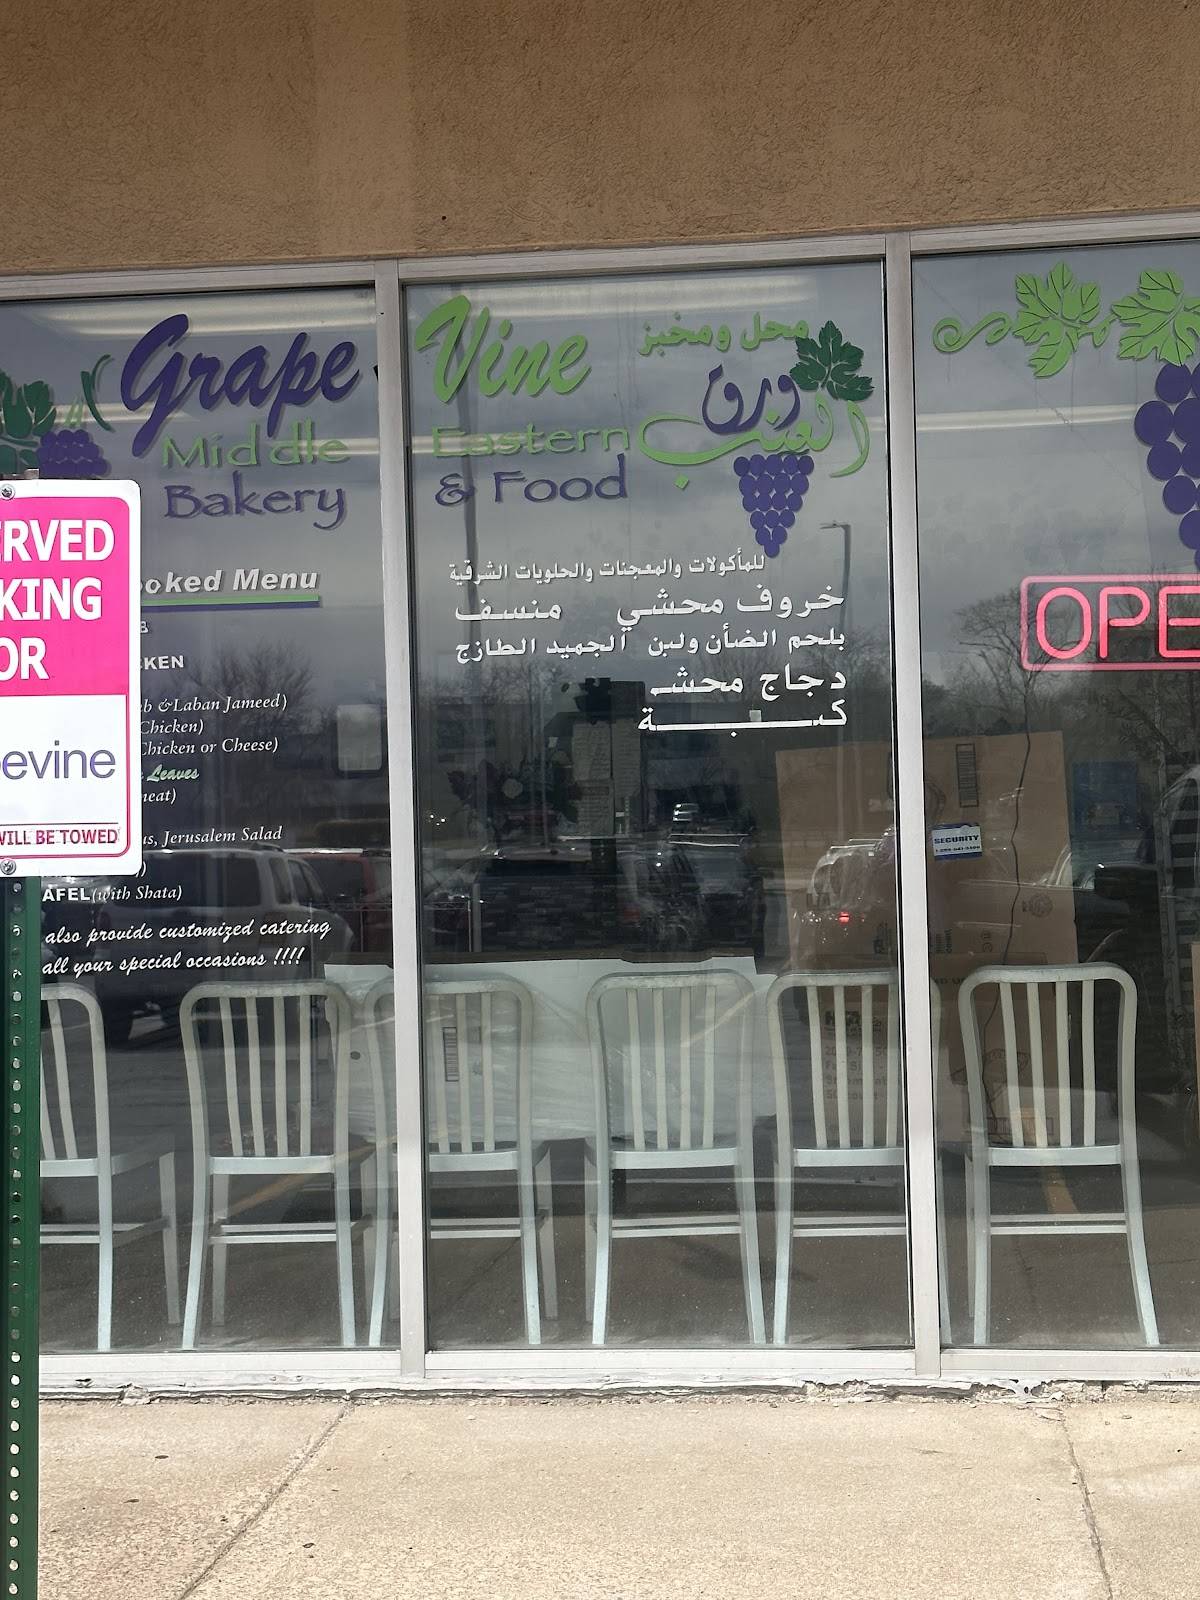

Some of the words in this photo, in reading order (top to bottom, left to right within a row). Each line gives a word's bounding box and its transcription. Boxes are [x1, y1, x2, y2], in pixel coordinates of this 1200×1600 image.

[638, 312, 731, 356] ومخبز
[741, 312, 809, 351] محل
[121, 314, 359, 457] Grape
[415, 295, 591, 403] Vine
[703, 364, 801, 435] ورق
[162, 418, 349, 468] Middle
[432, 423, 629, 458] Eastern
[637, 391, 870, 490] العنب
[164, 471, 347, 530] Bakery
[435, 472, 475, 507] &
[494, 453, 628, 503] Food
[0, 519, 115, 562] RVED
[449, 559, 508, 585] الشرقية
[515, 561, 594, 584] والحلويات
[688, 547, 765, 577] للمأكولات
[141, 570, 223, 594] oked
[232, 568, 318, 591] Menu
[0, 577, 102, 621] KING
[455, 599, 562, 621] منسف
[616, 588, 725, 631] محشي
[736, 584, 845, 617] خروف
[1036, 585, 1200, 660] OPE
[455, 637, 536, 664] الطازج
[546, 632, 628, 659] الجميد
[648, 631, 700, 657] ولبن
[705, 622, 777, 655] الضأن
[788, 627, 846, 653] بلحم
[140, 655, 185, 671] KEN
[759, 663, 848, 701] دجاج
[223, 693, 288, 714] Jameed)
[0, 740, 116, 780] evine
[200, 743, 217, 754] or
[221, 736, 279, 754] Cheese)
[146, 763, 200, 782] Leaves
[36, 829, 55, 845] BE
[59, 828, 118, 845] TOWED
[161, 828, 236, 848] Jerusalem
[241, 825, 284, 842] Salad
[933, 834, 980, 845] SECURITY
[135, 884, 183, 901] Shata)
[45, 926, 82, 945] also
[86, 923, 154, 948] provide
[158, 918, 254, 944] customized
[259, 918, 332, 940] catering
[42, 956, 69, 976] all
[73, 961, 114, 979] your
[119, 951, 183, 976] special
[186, 951, 267, 968] occasions
[273, 946, 306, 966] !!!!
